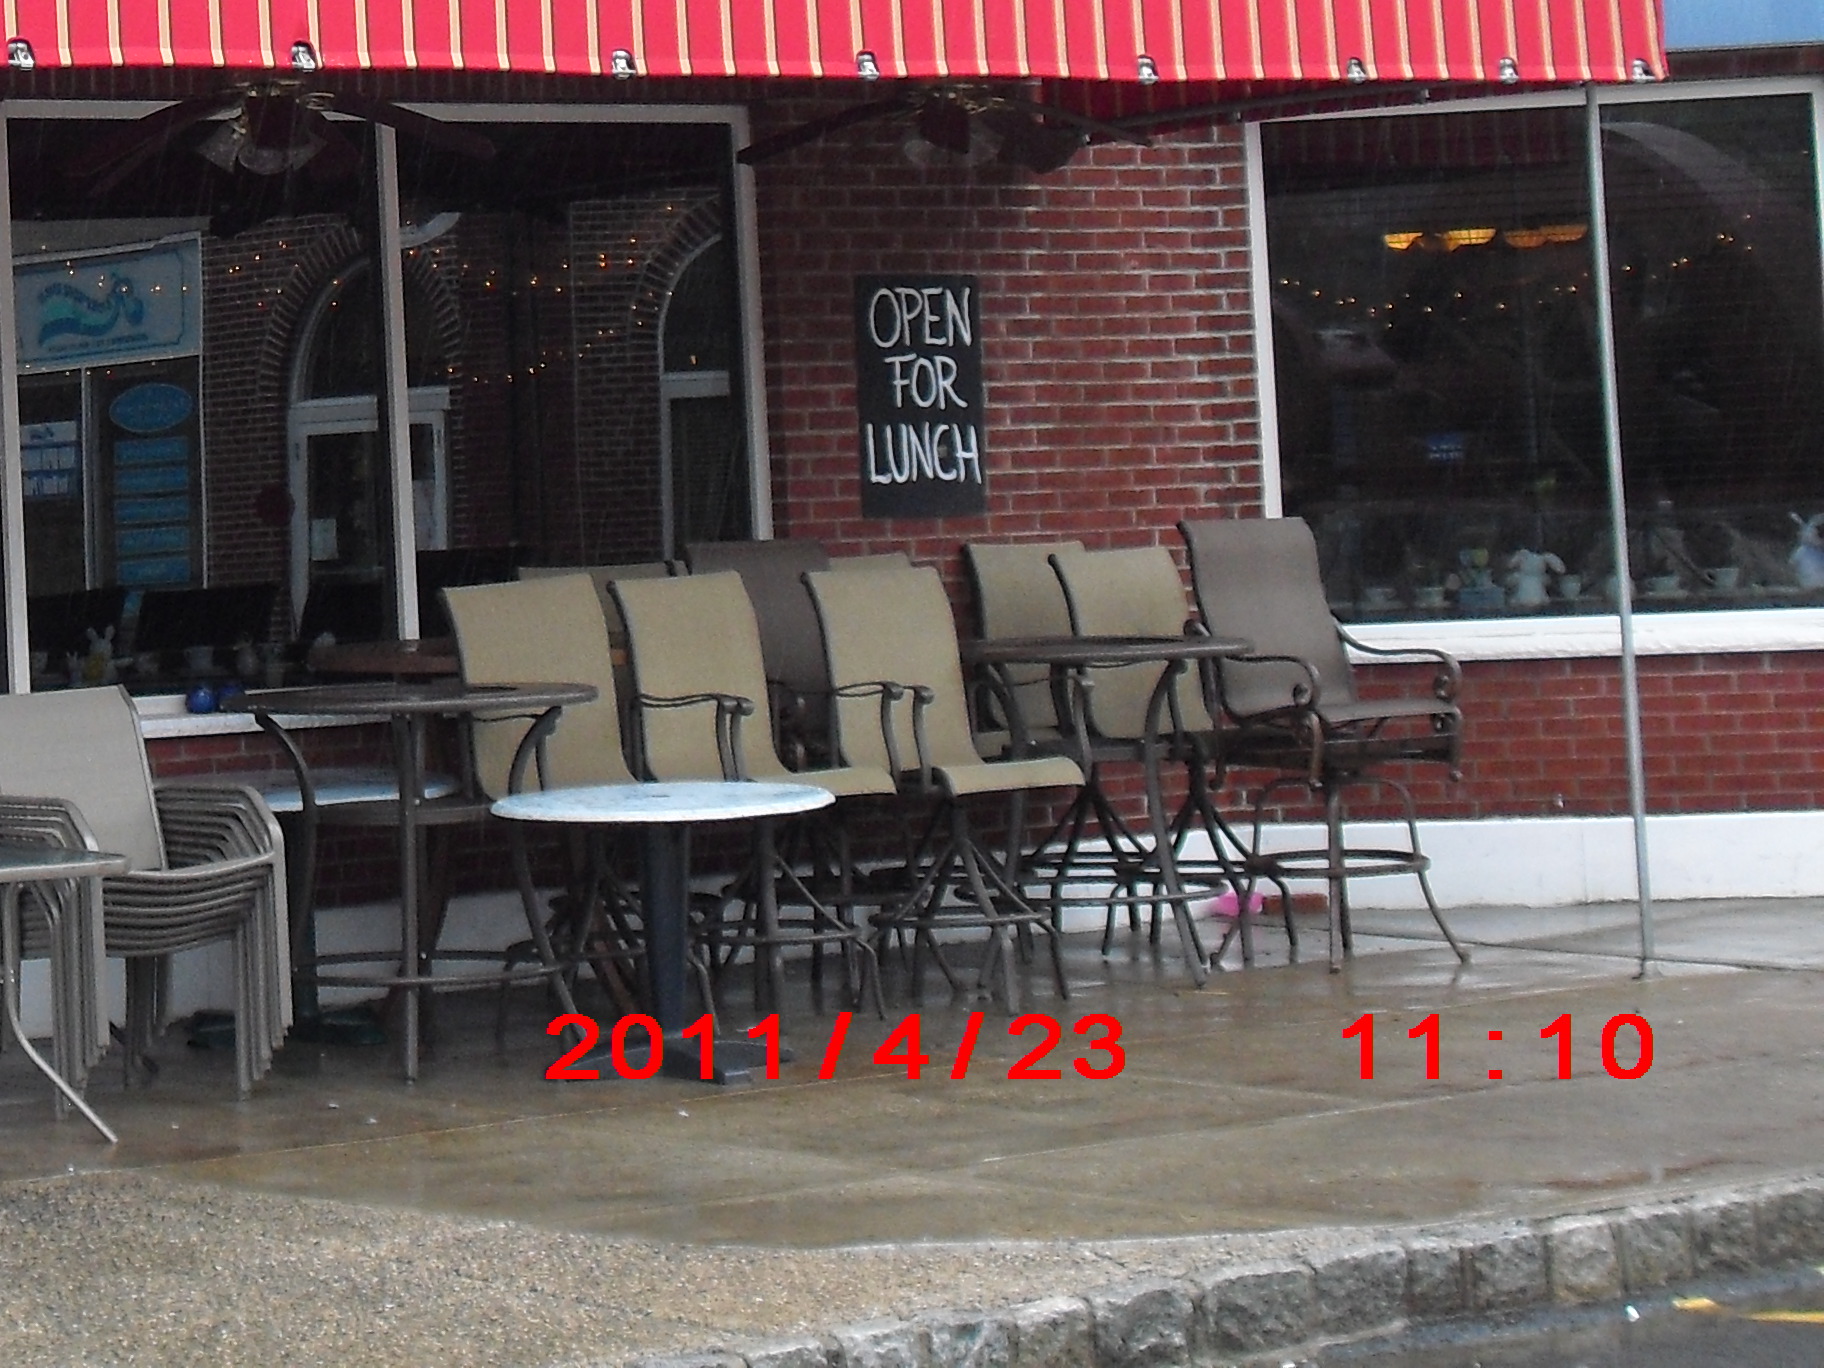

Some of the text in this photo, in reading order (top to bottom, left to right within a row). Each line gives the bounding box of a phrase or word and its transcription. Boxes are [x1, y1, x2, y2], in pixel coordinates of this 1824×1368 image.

[869, 287, 973, 348] OPEN
[883, 353, 969, 410] FOR
[865, 421, 983, 485] LUNCH
